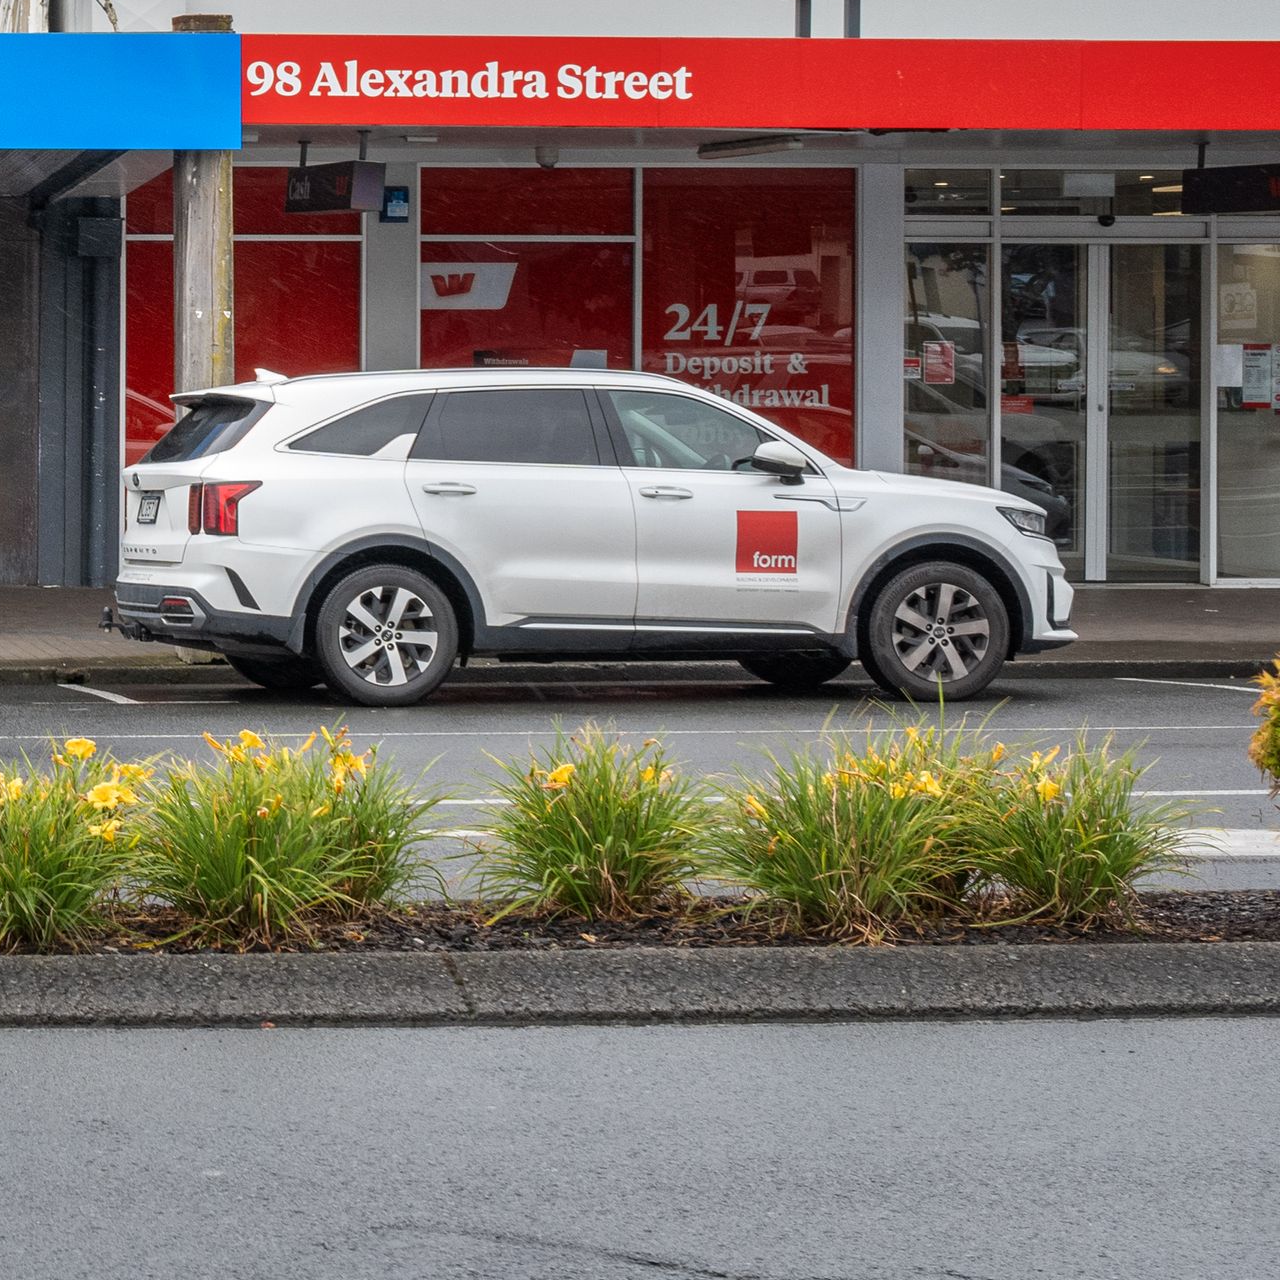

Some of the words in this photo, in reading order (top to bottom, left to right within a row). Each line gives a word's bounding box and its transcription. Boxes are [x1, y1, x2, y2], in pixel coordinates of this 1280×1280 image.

[246, 61, 301, 97] 98
[309, 60, 549, 100] Alexandra
[555, 64, 694, 101] Street
[288, 176, 311, 201] Cash
[664, 301, 772, 347] 24/7
[483, 358, 529, 366] Withdrawals
[664, 351, 775, 380] Deposit
[786, 352, 809, 374] &
[695, 383, 831, 408] thdrawal
[752, 551, 796, 569] form
